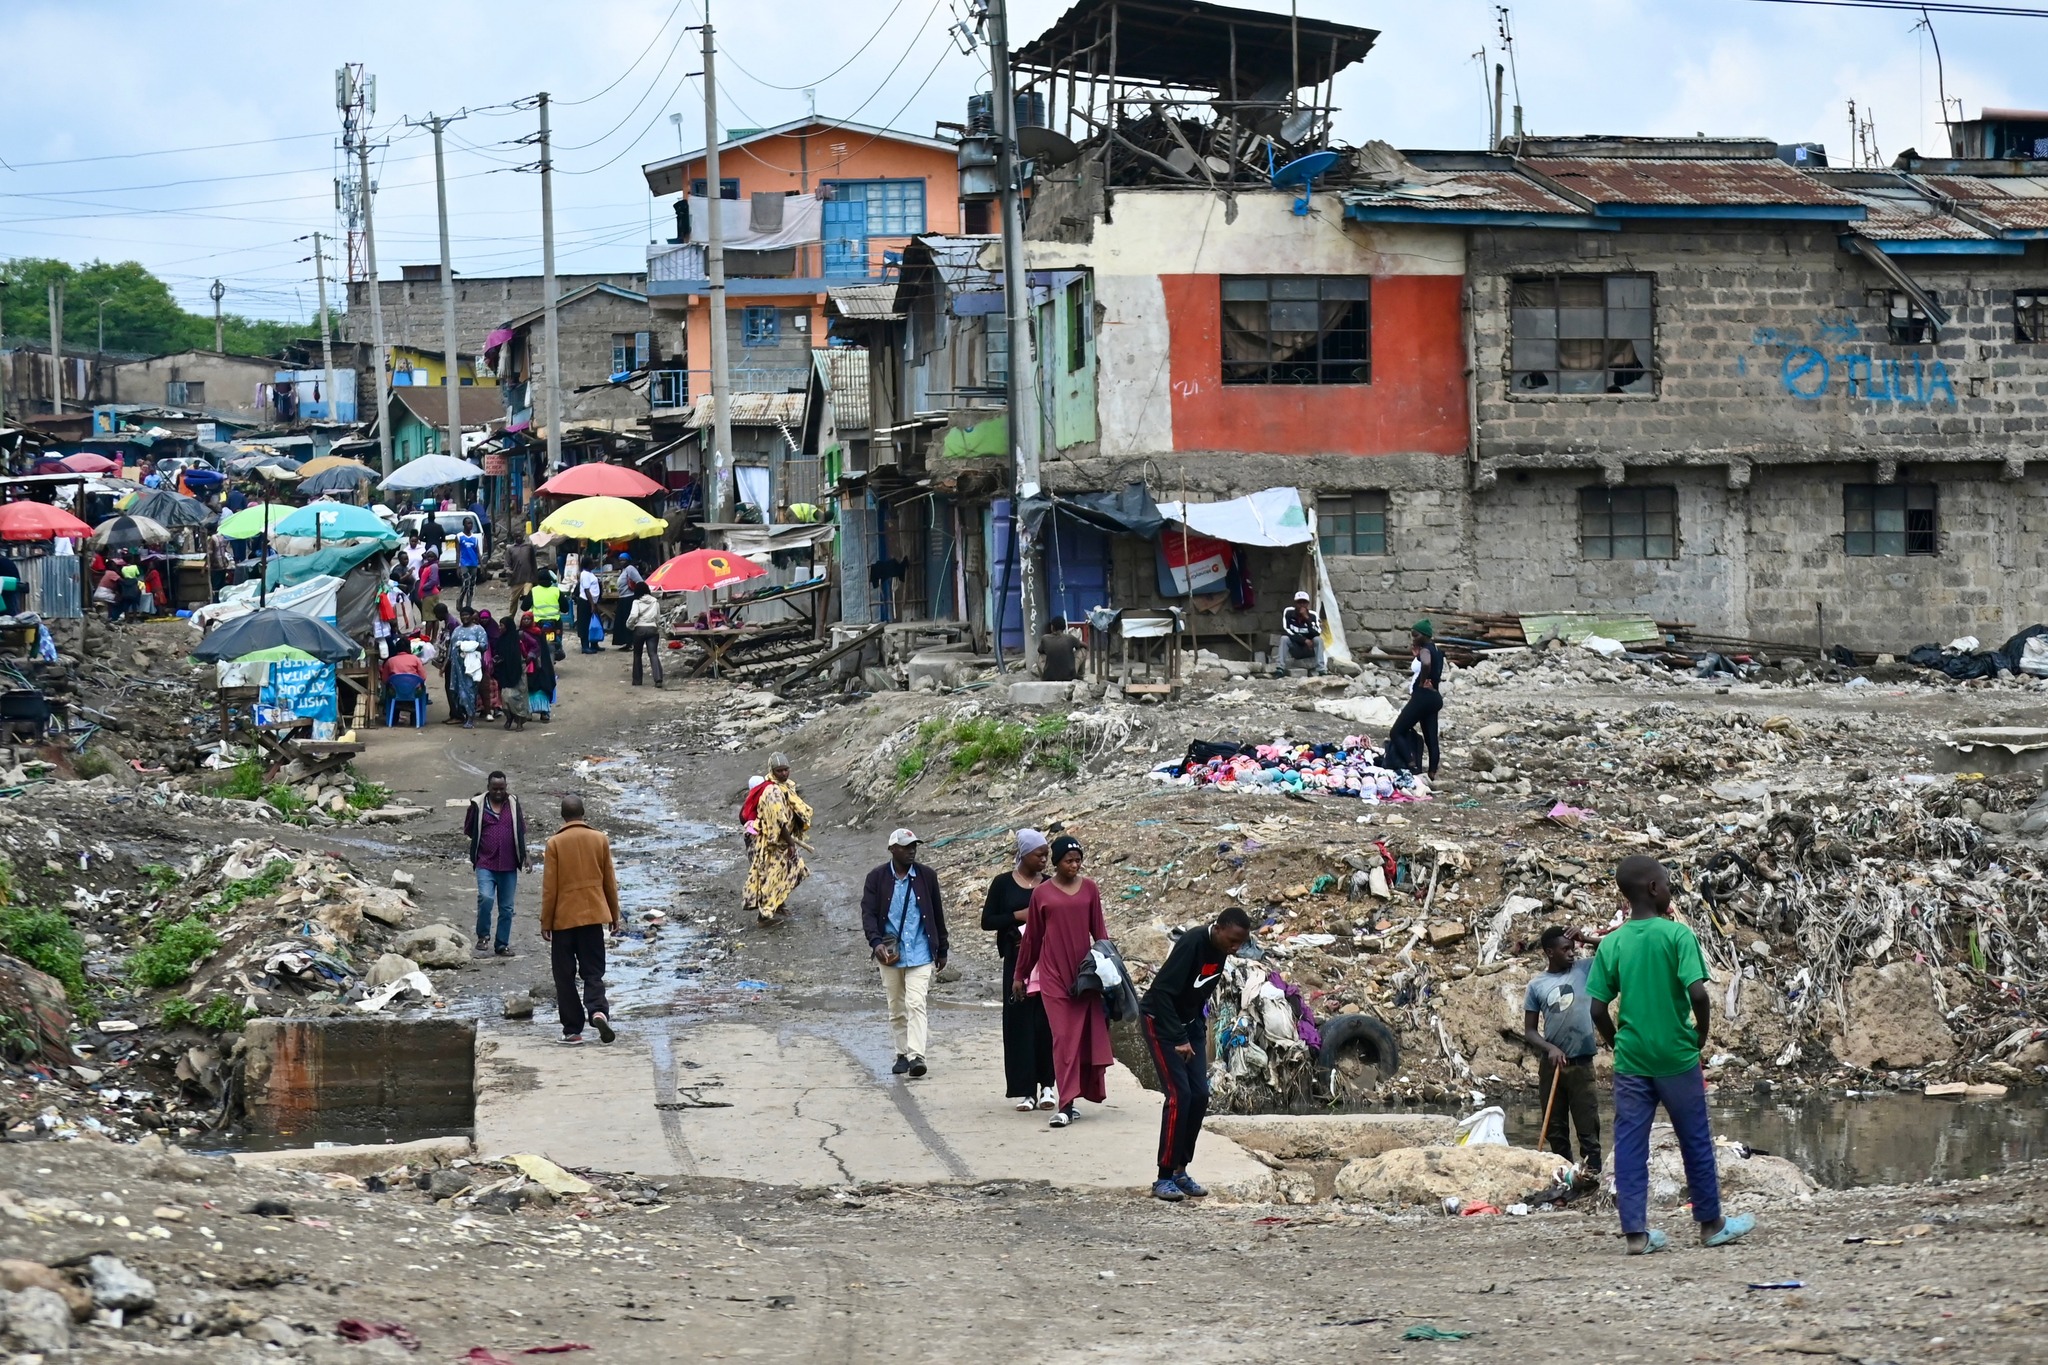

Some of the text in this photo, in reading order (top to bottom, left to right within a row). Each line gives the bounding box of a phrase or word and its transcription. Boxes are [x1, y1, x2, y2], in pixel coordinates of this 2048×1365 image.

[277, 667, 329, 682] CAPITAL
[278, 681, 326, 696] AT OUR
[297, 696, 329, 709] VISIT
